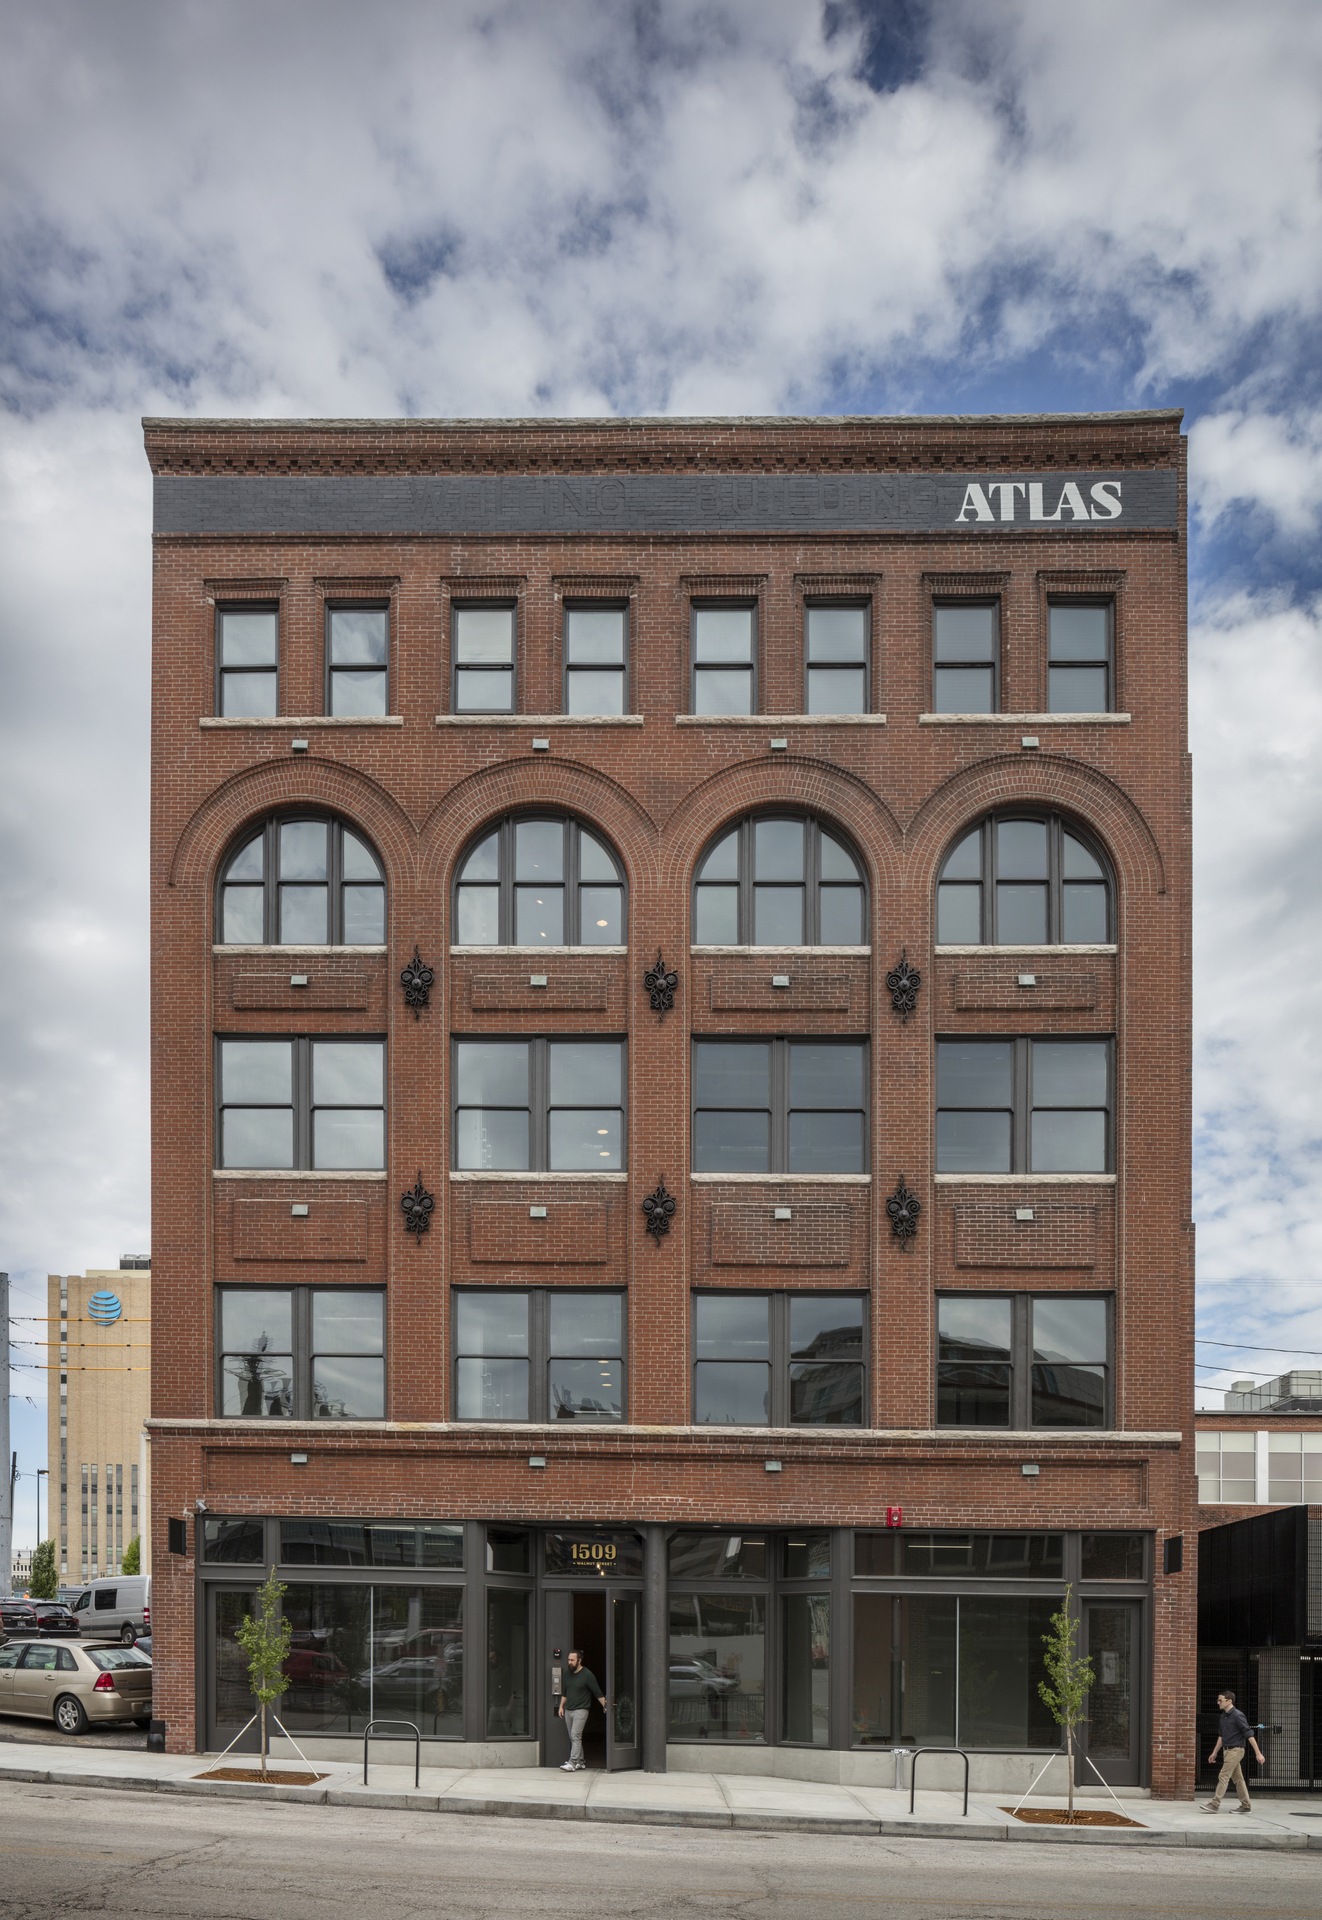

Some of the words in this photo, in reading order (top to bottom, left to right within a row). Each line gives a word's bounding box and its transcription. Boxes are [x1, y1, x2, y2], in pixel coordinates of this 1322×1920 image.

[695, 477, 939, 517] BUILDING
[955, 481, 1123, 522] ATLAS
[571, 1543, 617, 1560] 1509
